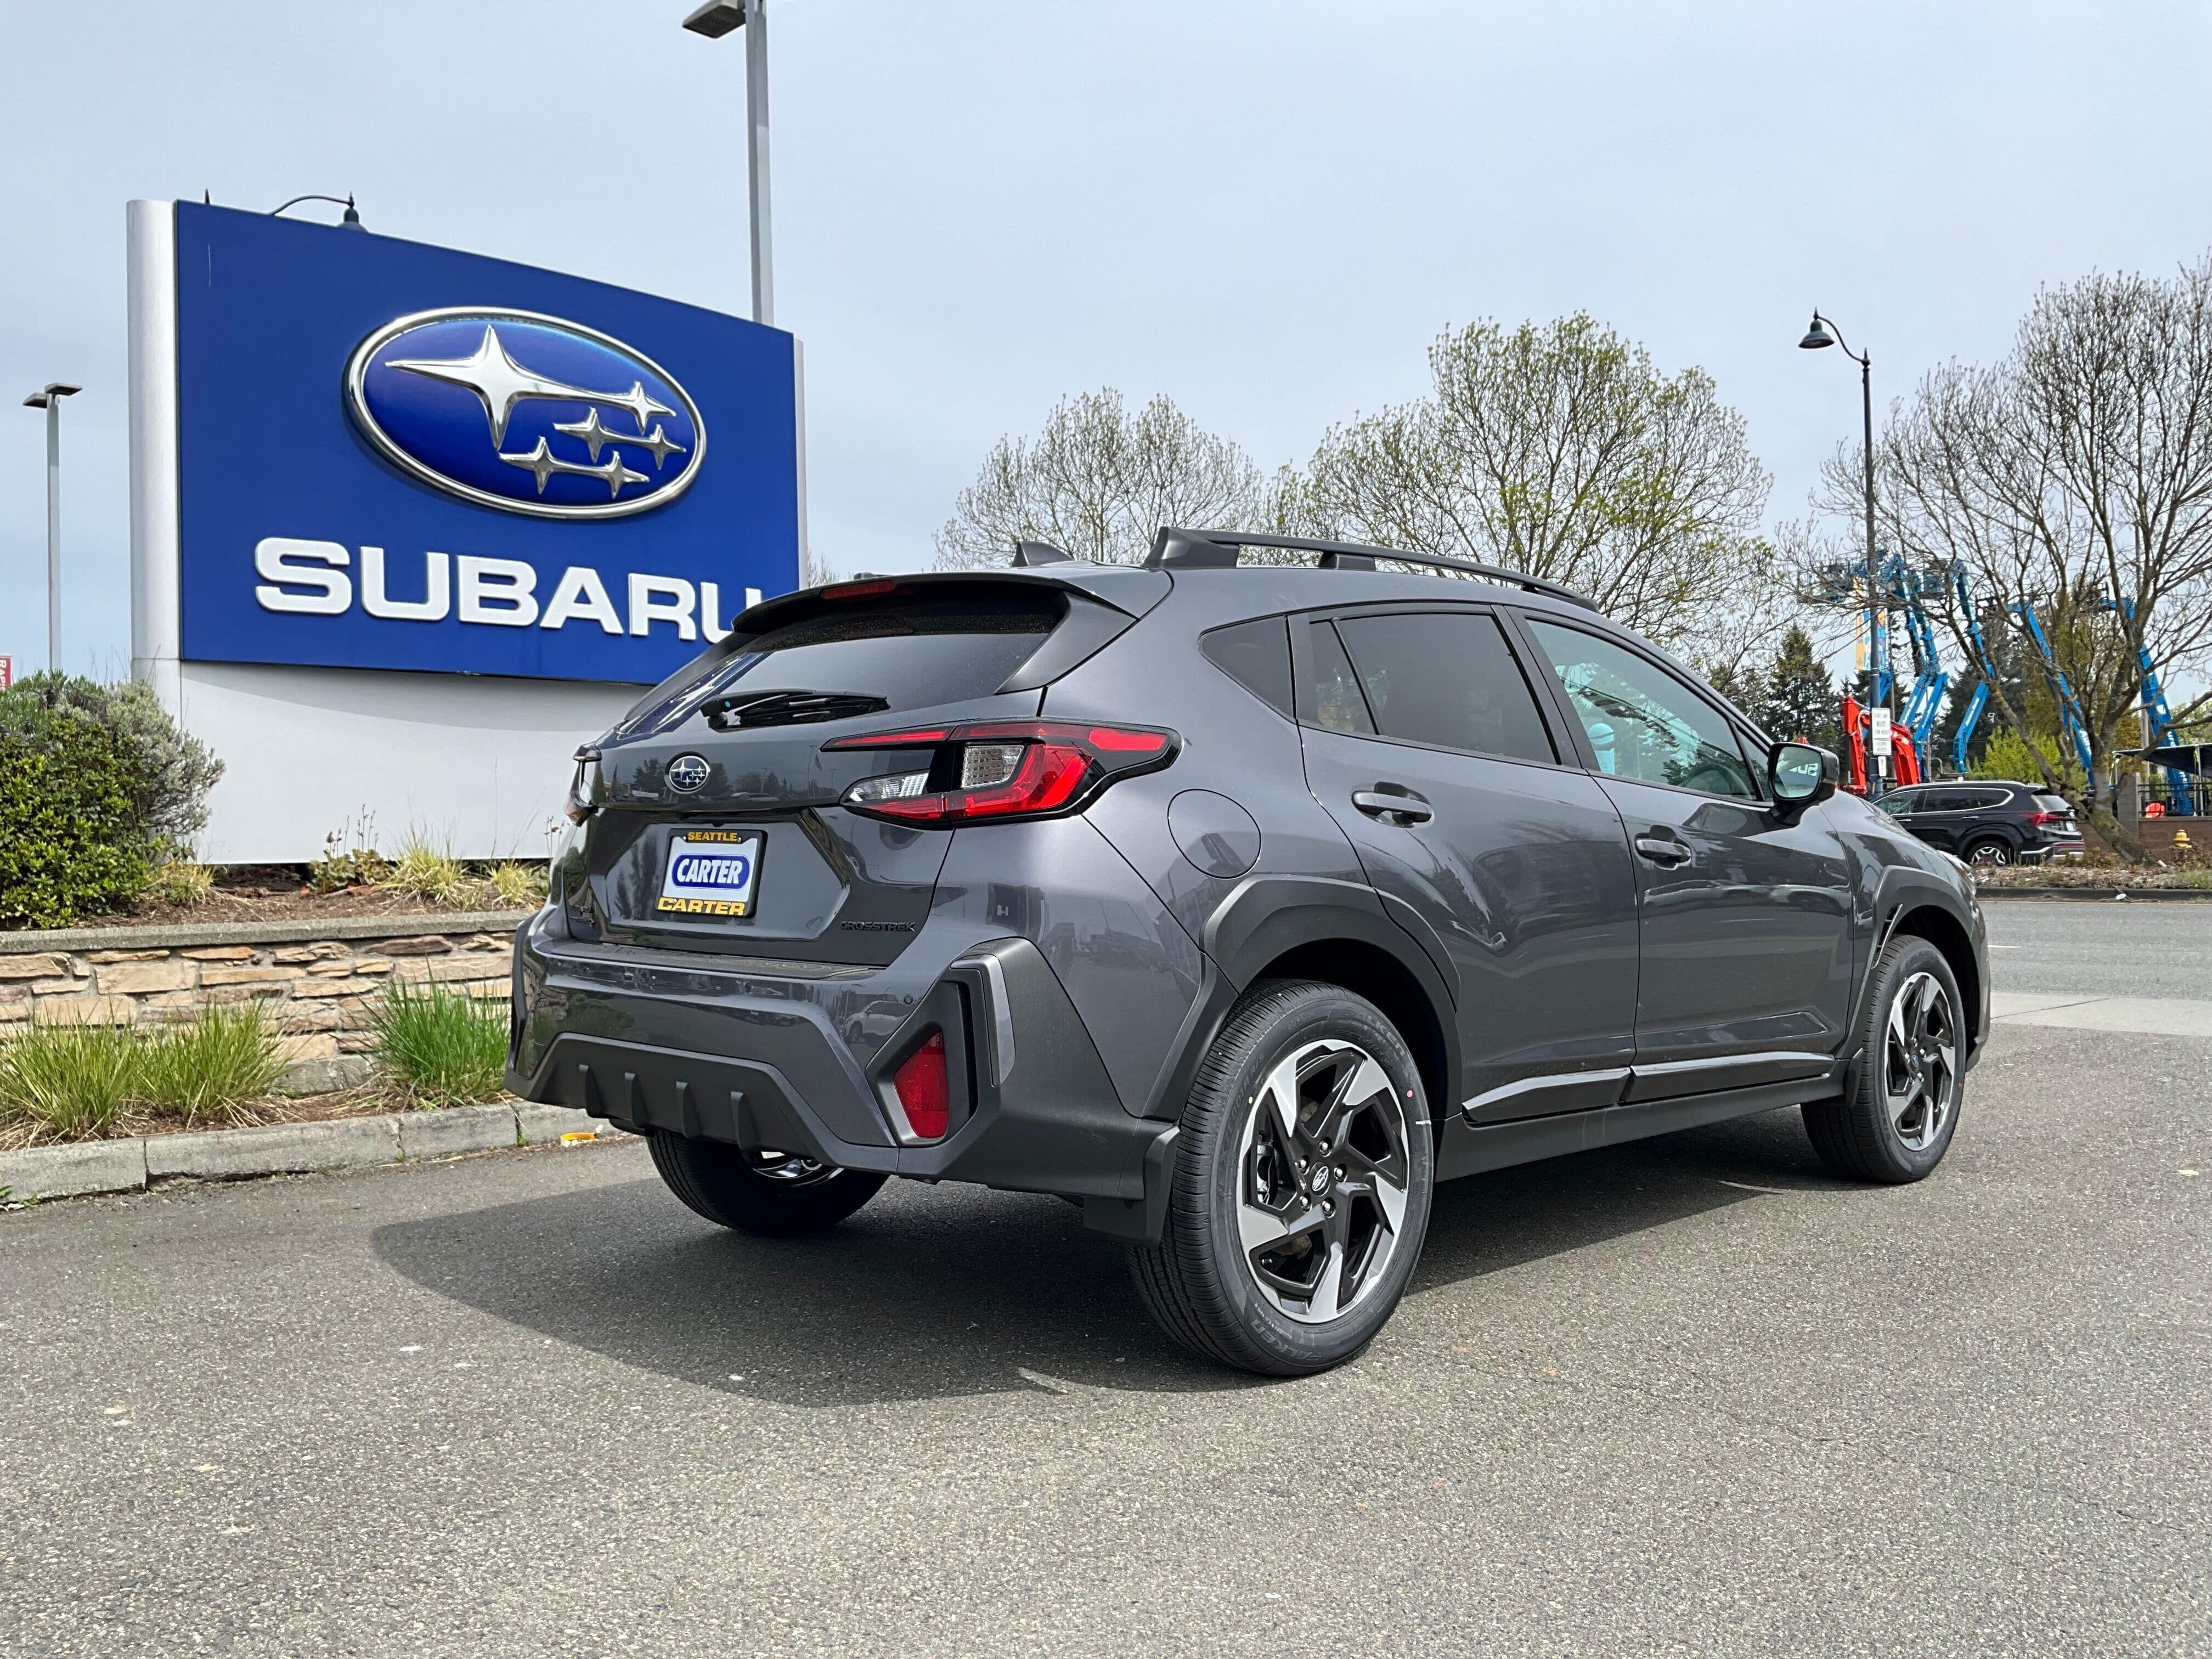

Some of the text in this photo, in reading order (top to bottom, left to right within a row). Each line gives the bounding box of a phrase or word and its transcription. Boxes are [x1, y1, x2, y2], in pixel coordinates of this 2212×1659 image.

[255, 537, 761, 644] SUBARU
[687, 831, 738, 842] SEATTLE
[677, 859, 743, 884] CARTER
[658, 897, 745, 916] CARTER
[840, 921, 916, 932] CROSSTREK
